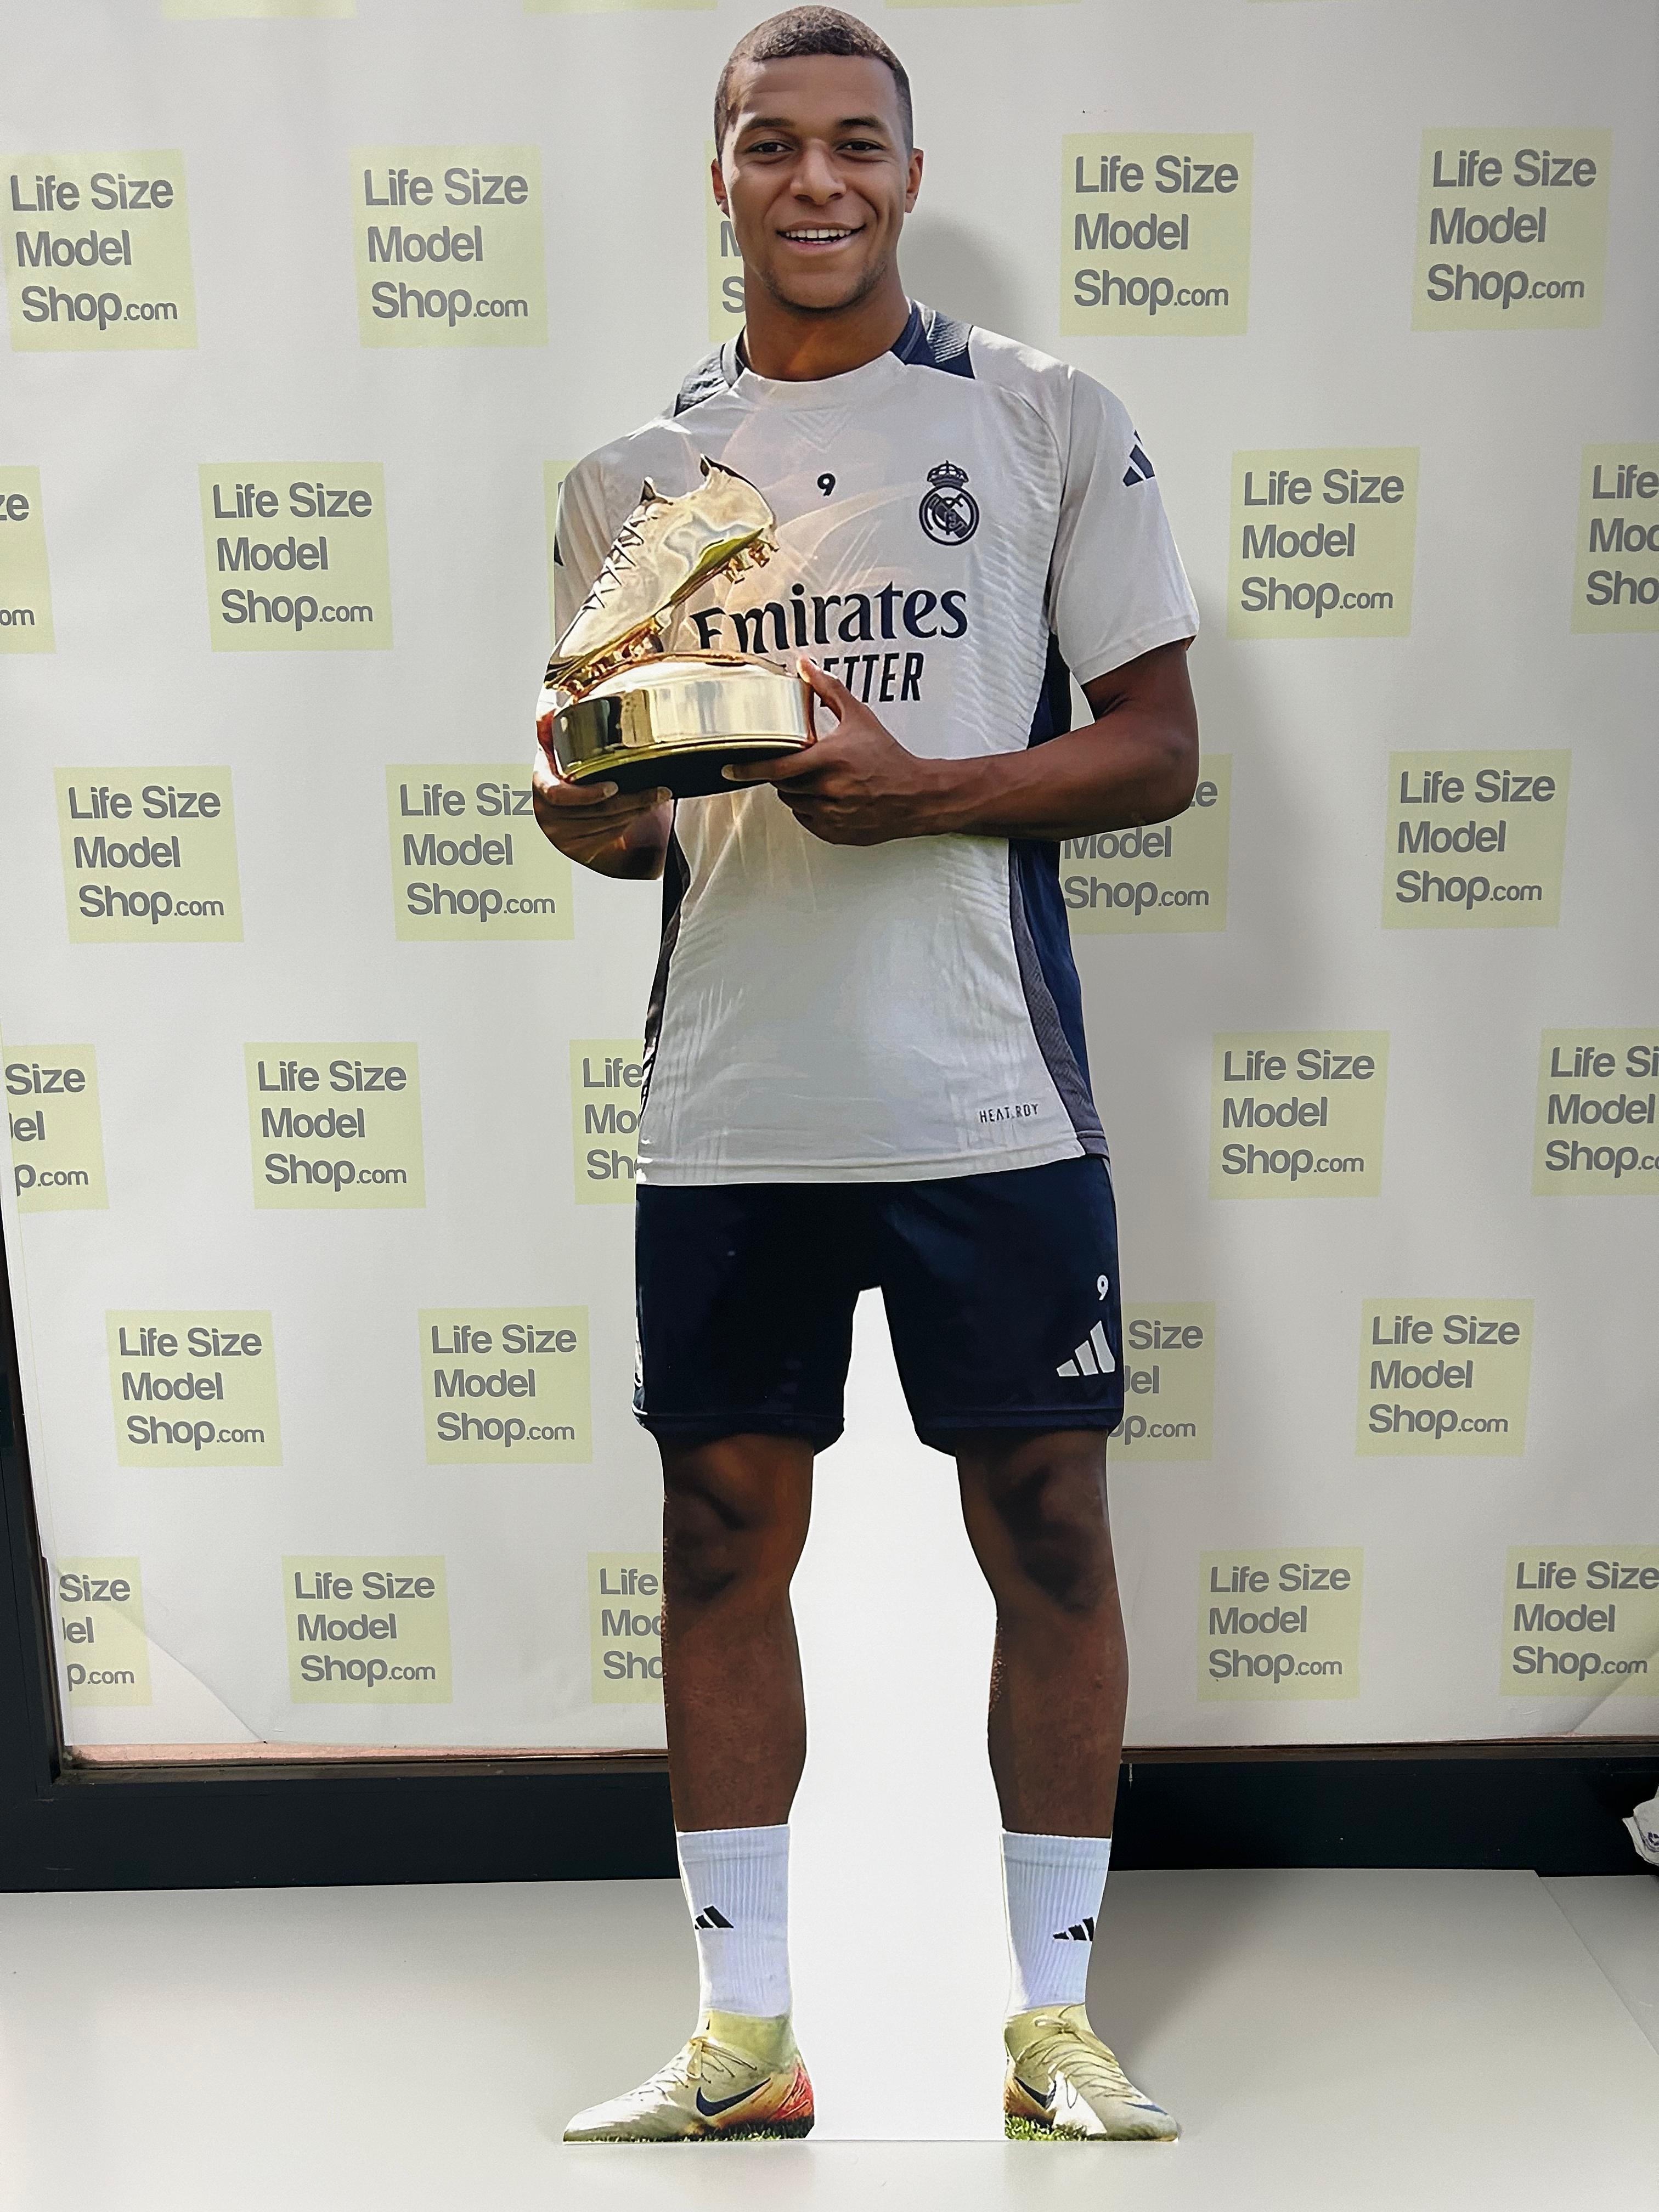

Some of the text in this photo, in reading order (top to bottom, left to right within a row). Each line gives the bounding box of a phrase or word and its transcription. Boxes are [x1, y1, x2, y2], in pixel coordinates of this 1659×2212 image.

[1076, 155, 1238, 193] Life Size
[1434, 149, 1596, 187] Life Size
[10, 173, 173, 211] Life Size
[364, 168, 528, 205] Life Size
[1075, 213, 1188, 250] Model
[1430, 207, 1546, 244] Model
[16, 230, 131, 267] Model
[368, 225, 483, 262] Model
[1074, 269, 1228, 315] Shop.com
[1427, 264, 1584, 309] Shop.com
[22, 286, 177, 330] Shop.com
[372, 281, 528, 327] Shop.com
[817, 473, 836, 496] 9
[1244, 469, 1404, 505] Life Size
[1593, 465, 1659, 499] Life
[213, 482, 372, 518] Life Size
[217, 537, 328, 571] Model
[1243, 523, 1355, 558] Model
[222, 589, 373, 631] Shop.com
[1242, 577, 1393, 618] Shop.com
[690, 582, 968, 654] Emirates
[814, 653, 924, 707] TTER
[69, 786, 221, 819] Life Size
[400, 783, 532, 816] Life Siz
[1401, 770, 1555, 803] Life Size
[74, 836, 180, 868] Model
[403, 834, 512, 865] Model
[1064, 825, 1172, 859] Model
[1398, 820, 1506, 853] Model
[79, 885, 224, 924] Shop.com
[407, 883, 555, 922] Shop.com
[1065, 876, 1209, 916] Shop.com
[1396, 870, 1542, 910] Shop.com
[258, 1060, 407, 1091] Life Size
[583, 1058, 642, 1087] Life
[1224, 1049, 1374, 1081] Life Size
[1551, 1046, 1658, 1077] Life Si
[5, 1064, 85, 1095] Size
[262, 1108, 365, 1138] Model
[1223, 1097, 1327, 1128] Model
[1548, 1094, 1655, 1124] Model
[266, 1154, 407, 1192] Shop.com
[1222, 1144, 1364, 1181] Shop.com
[1545, 1140, 1658, 1178] Shop.c
[14, 1165, 88, 1197] p.com
[1097, 1274, 1109, 1300] 9
[119, 1328, 262, 1357] Life Size
[432, 1324, 577, 1353] Life Size
[1128, 1320, 1203, 1350] Size
[1373, 1315, 1520, 1345] Life Size
[122, 1372, 223, 1400] Model
[435, 1369, 535, 1397] Model
[1370, 1360, 1473, 1389] Model
[127, 1415, 264, 1451] Shop.com
[437, 1412, 574, 1447] Shop.com
[1369, 1404, 1508, 1439] Shop.com
[60, 1574, 130, 1602] Size
[295, 1572, 435, 1599] Life Size
[600, 1568, 658, 1595] Life
[1210, 1564, 1350, 1593] Life Size
[1517, 1561, 1658, 1589] Life Size
[298, 1613, 397, 1641] Model
[1210, 1606, 1307, 1635] Model
[1514, 1604, 1615, 1632] Model
[67, 1663, 134, 1692] p.com
[301, 1655, 435, 1687] Shop.com
[1209, 1649, 1342, 1683] Shop.com
[1513, 1646, 1647, 1681] Shop.com
